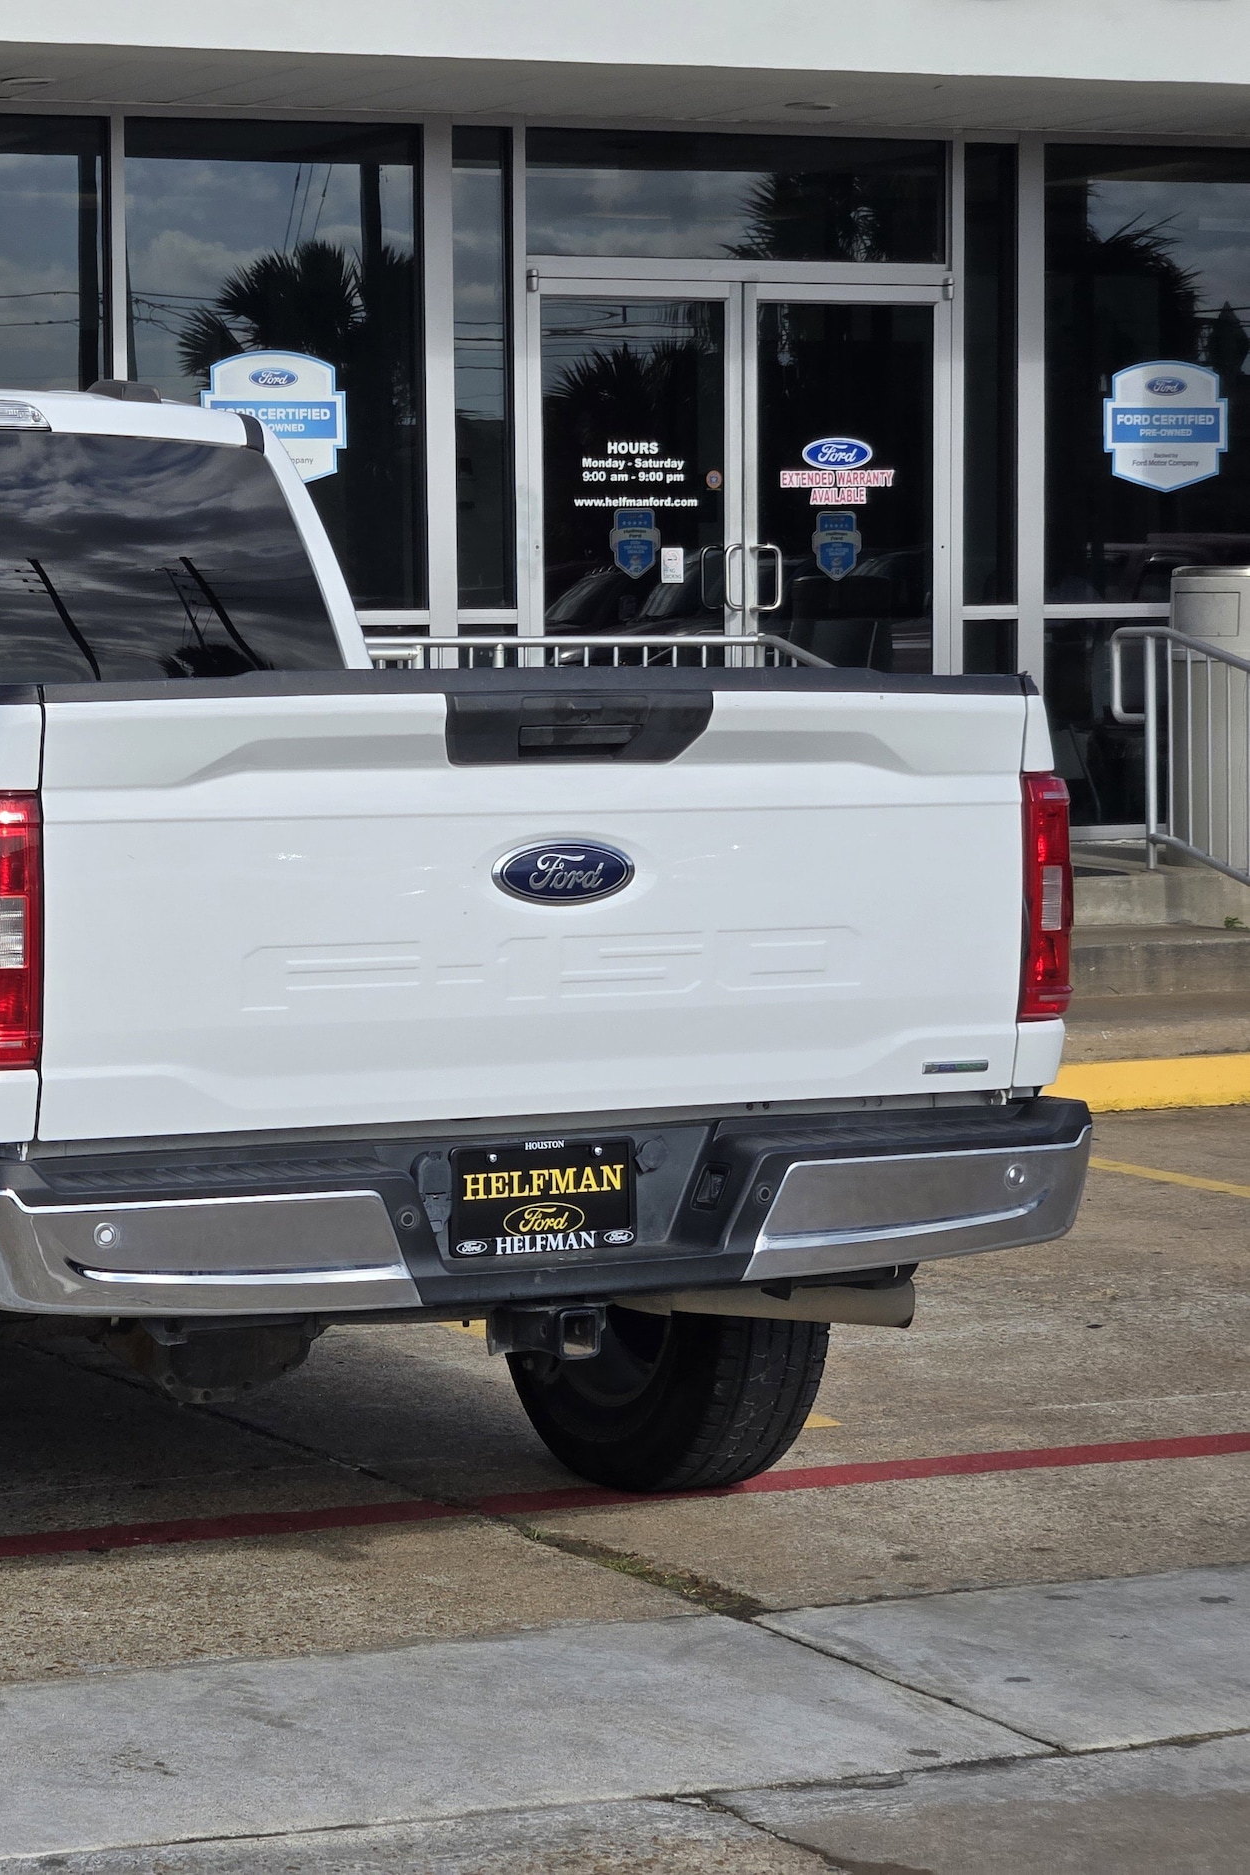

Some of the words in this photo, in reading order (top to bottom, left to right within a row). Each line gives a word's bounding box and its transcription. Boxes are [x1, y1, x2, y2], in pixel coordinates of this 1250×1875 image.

[258, 370, 289, 385] Ford
[1153, 379, 1180, 392] Ford
[258, 407, 331, 420] CERTIFIED
[1116, 414, 1150, 425] FORD
[1152, 414, 1215, 425] CERTIFIED
[267, 423, 305, 432] OWNED
[1139, 428, 1193, 437] PRE-OWNED
[607, 441, 659, 454] HOURS
[817, 443, 858, 463] Ford
[582, 458, 625, 470] Monday
[634, 458, 685, 470] Saturday
[582, 471, 606, 482] 9:00
[610, 472, 629, 482] am
[638, 471, 663, 482] 9:00
[666, 472, 685, 484] pm
[781, 472, 835, 487] EXTENDED
[836, 471, 893, 487] WARRANTY
[574, 496, 699, 507] www.helfmanford.com
[811, 488, 865, 503] AVAILABLE
[528, 853, 604, 890] Ford
[524, 1140, 565, 1150] HOUSTON
[463, 1164, 624, 1201] HELFMAN
[519, 1207, 570, 1232] Ford
[461, 1241, 483, 1253] Ford
[495, 1230, 597, 1255] HELFMAN
[608, 1231, 630, 1243] Ford
